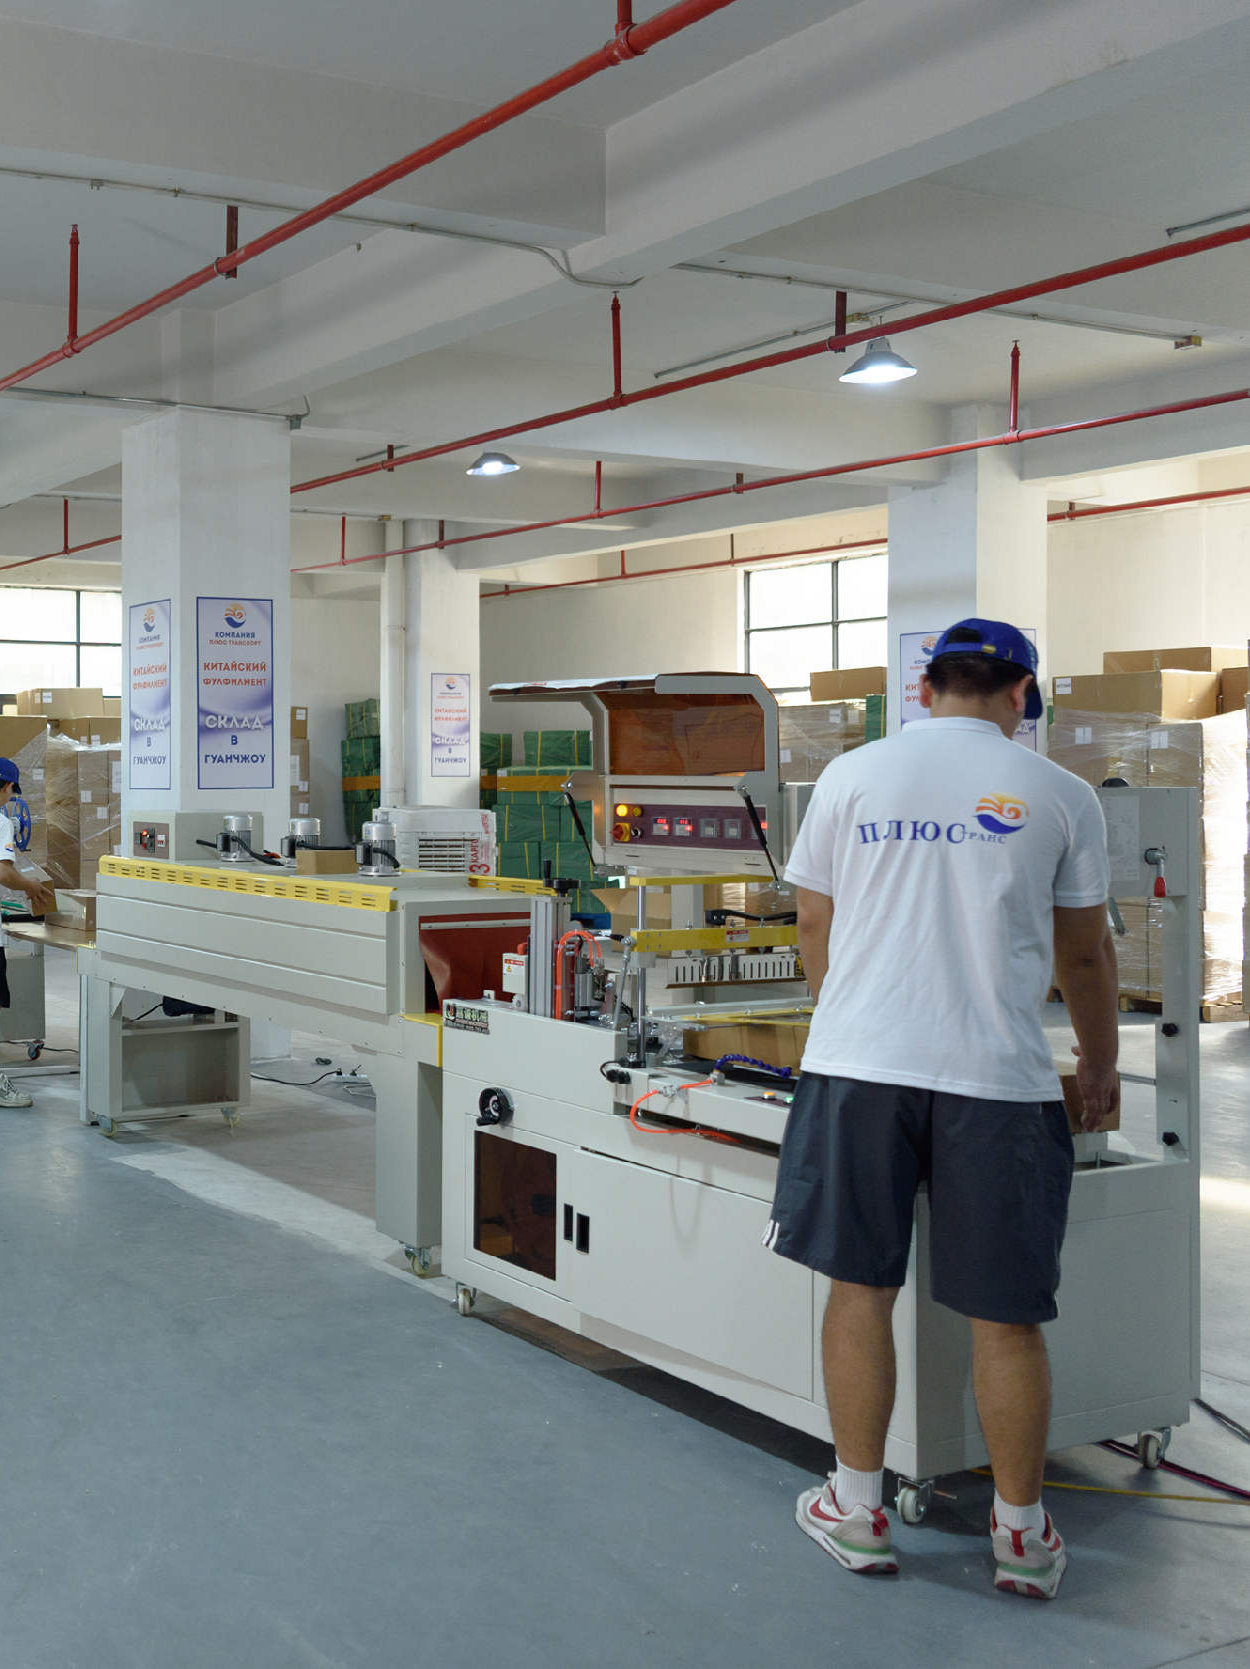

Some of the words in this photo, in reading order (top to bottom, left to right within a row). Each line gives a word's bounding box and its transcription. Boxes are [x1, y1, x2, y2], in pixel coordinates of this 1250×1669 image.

[215, 631, 255, 639] КОМПАНИЯ
[133, 662, 167, 677] КИТАЙСКИЙ
[203, 660, 266, 672] КИТАЙСКИЙ
[133, 678, 167, 690] ФУЛФИЛМЕНТ
[203, 677, 267, 687] ФУЛФИЛМЕНТ
[134, 717, 165, 732] СКЛАД
[205, 714, 264, 730] СКЛАД
[146, 737, 152, 747] В
[231, 735, 238, 745] В
[434, 736, 466, 745] СКЛАД
[133, 755, 167, 765] ГУАНЧЖОУ
[204, 754, 266, 764] ГУАНЧЖОУ
[857, 820, 966, 845] ПЛЮС
